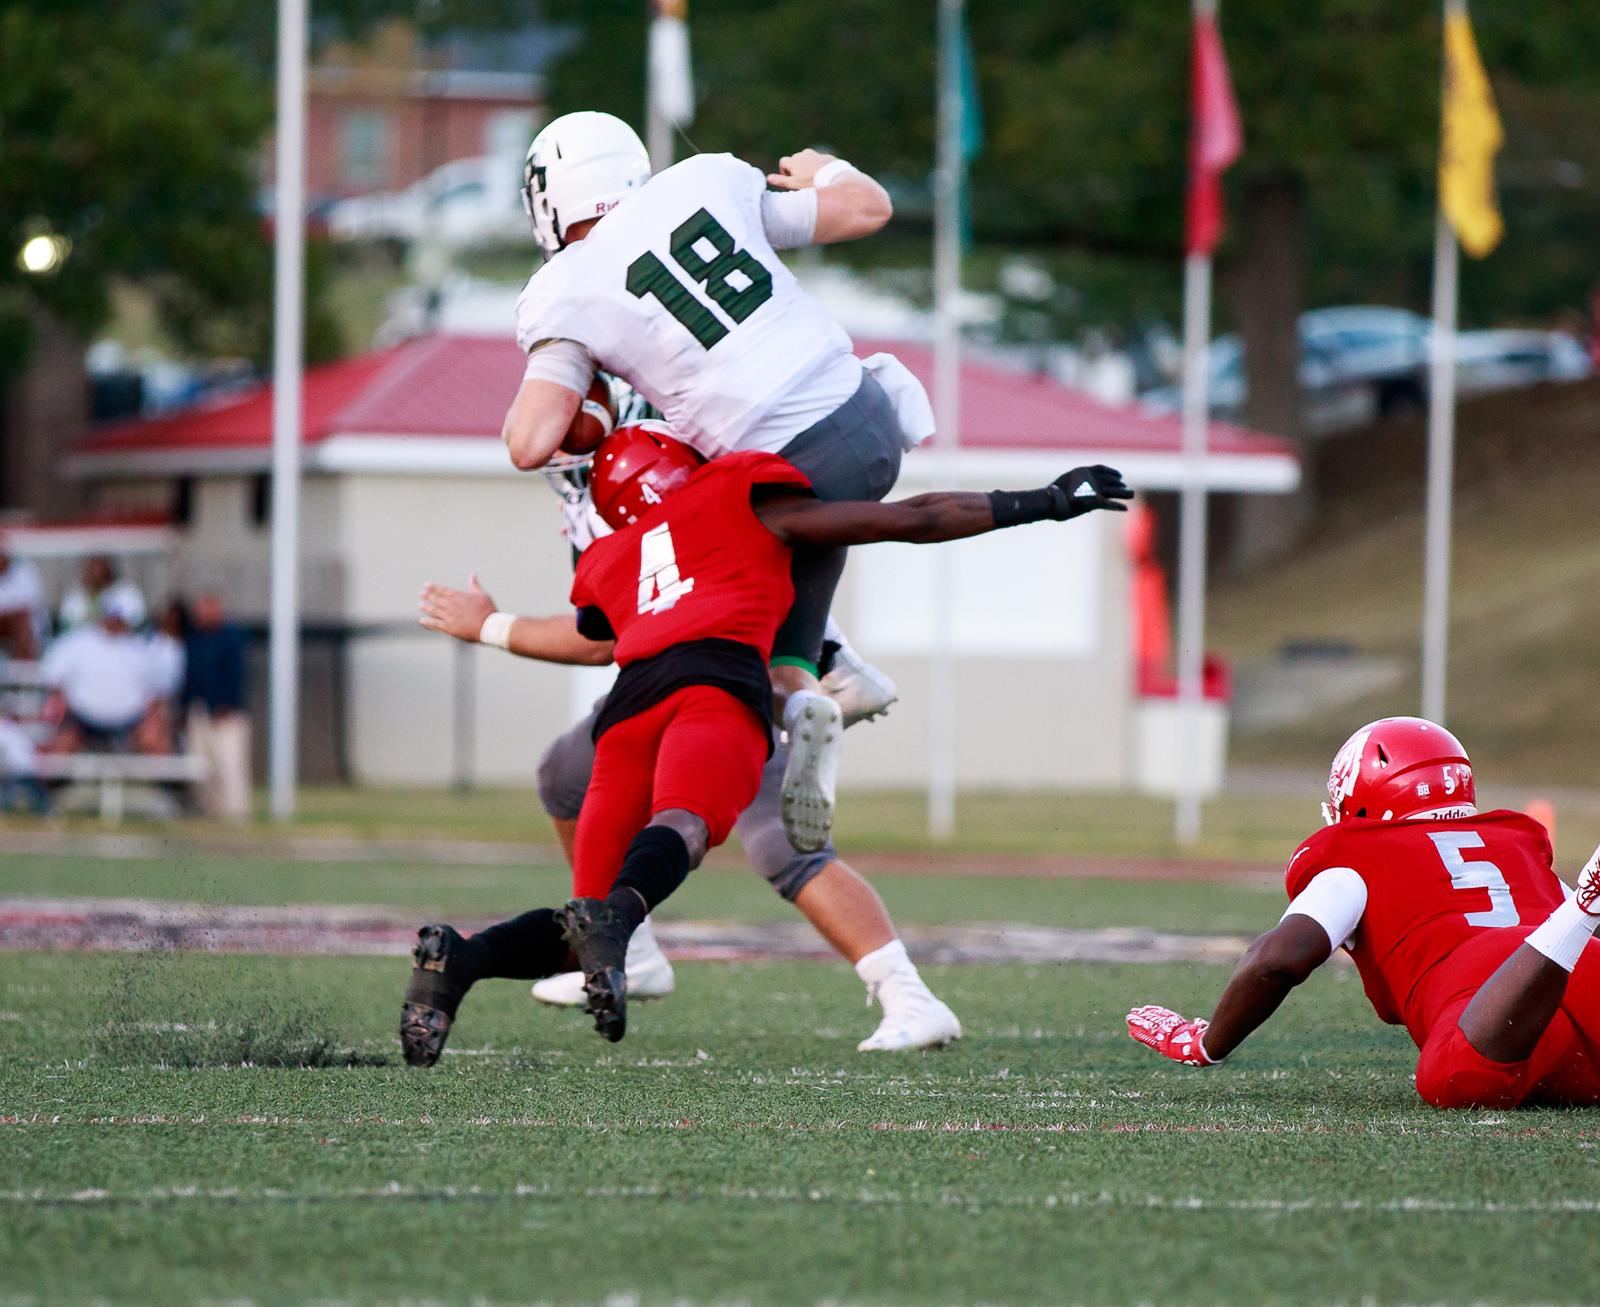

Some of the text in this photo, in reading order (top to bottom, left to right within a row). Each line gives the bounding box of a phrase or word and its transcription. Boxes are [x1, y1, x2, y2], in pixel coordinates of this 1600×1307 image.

[625, 207, 773, 352] 18
[641, 483, 662, 504] 4
[637, 521, 695, 615] 4
[1442, 766, 1456, 795] 5
[1426, 830, 1520, 928] 5
